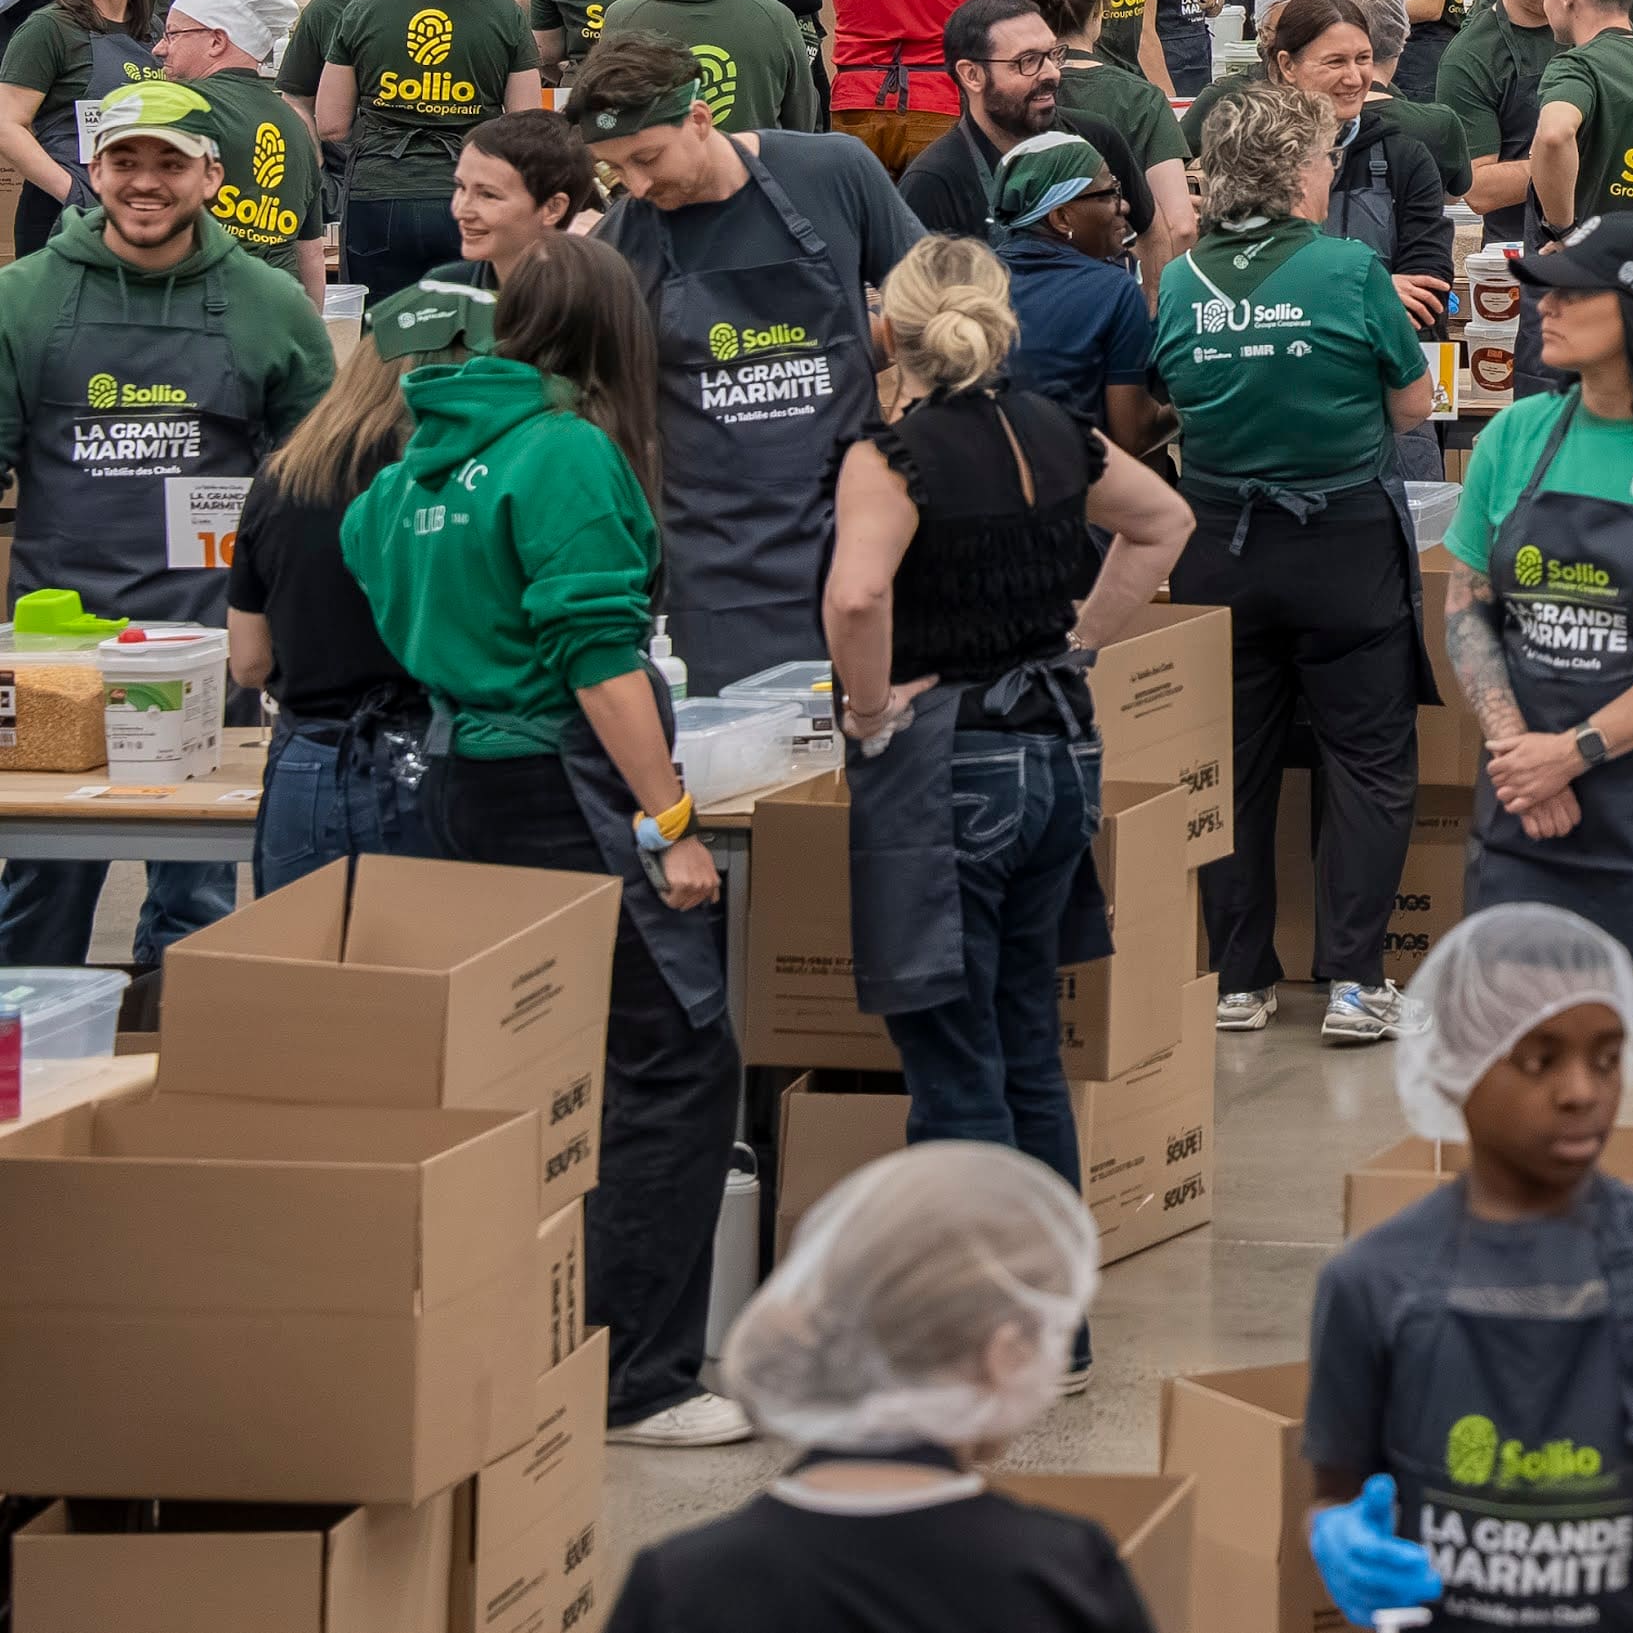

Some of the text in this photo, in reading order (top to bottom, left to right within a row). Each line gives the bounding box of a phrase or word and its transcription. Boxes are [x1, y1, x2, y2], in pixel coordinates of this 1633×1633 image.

[379, 71, 475, 102] Sollio
[210, 184, 298, 237] Sollio
[1253, 303, 1304, 321] Sollio
[741, 323, 806, 349] Sollio
[700, 356, 829, 388] LA GRANDE
[120, 383, 187, 403] Sollio
[702, 373, 833, 410] MARMITE
[724, 413, 737, 423] La
[770, 408, 786, 418] des
[786, 405, 815, 417] Chefs
[74, 420, 200, 441] LA GRANDE
[72, 437, 201, 461] MARMITE
[91, 467, 103, 476] La
[136, 466, 153, 475] des
[153, 465, 182, 474] Chefs
[205, 493, 245, 501] GRAND
[1547, 559, 1610, 587] Sollio
[1501, 1439, 1602, 1481] Sollio
[1421, 1504, 1472, 1548] LA
